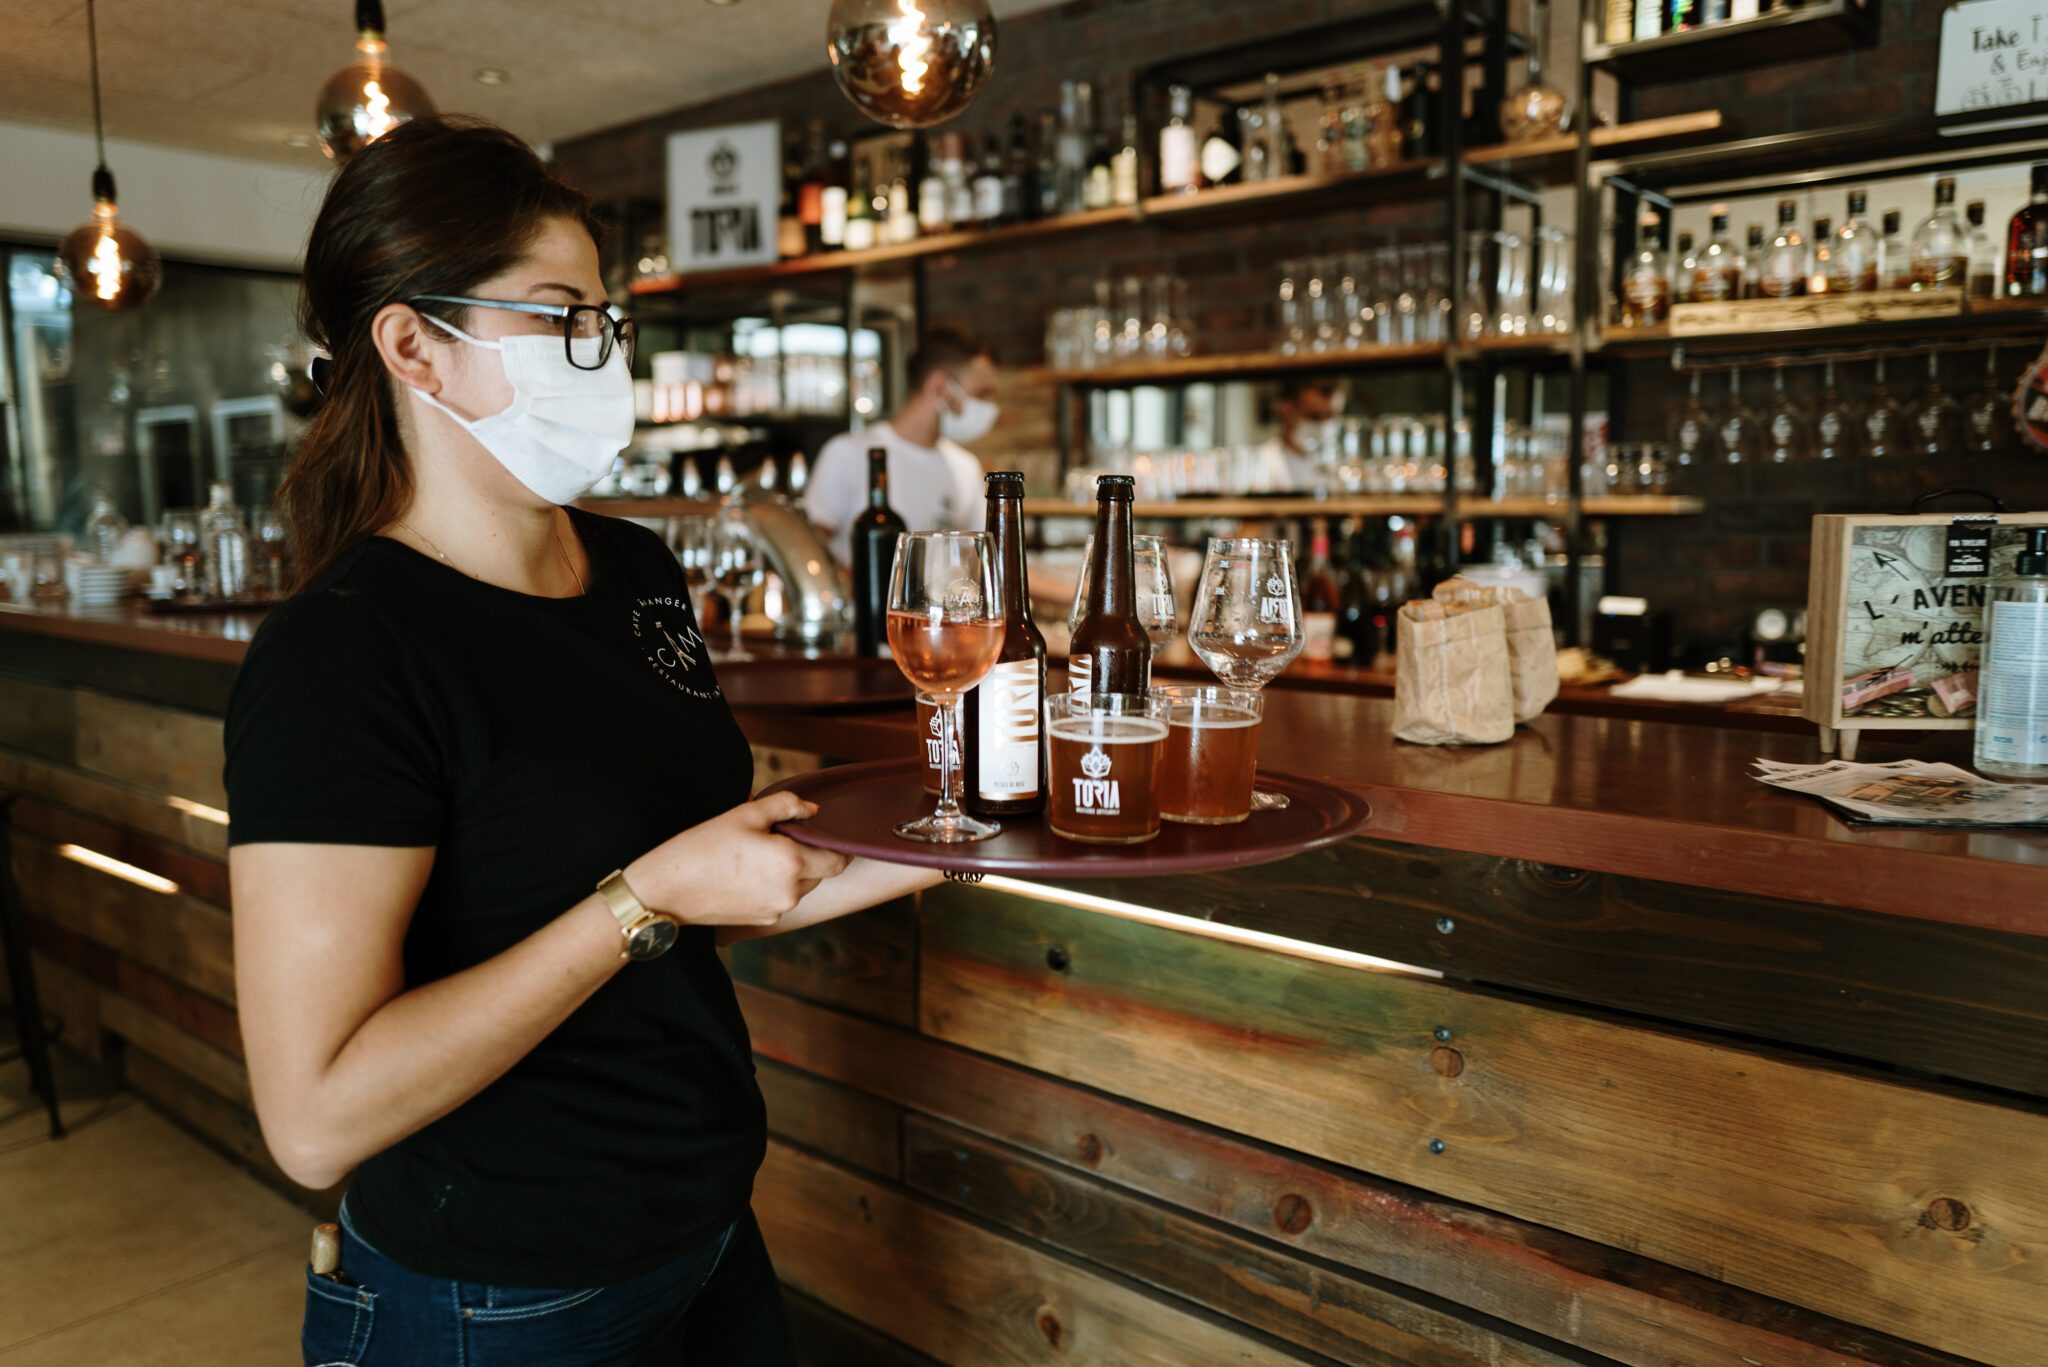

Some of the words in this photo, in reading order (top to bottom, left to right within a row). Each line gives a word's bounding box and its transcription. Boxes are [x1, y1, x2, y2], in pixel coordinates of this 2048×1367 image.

[1971, 28, 2018, 52] Take
[1991, 54, 2005, 75] &
[632, 610, 641, 637] CAVE
[1901, 621, 1984, 645] m'atte
[926, 738, 960, 765] TOA
[1072, 778, 1120, 808] TORIA
